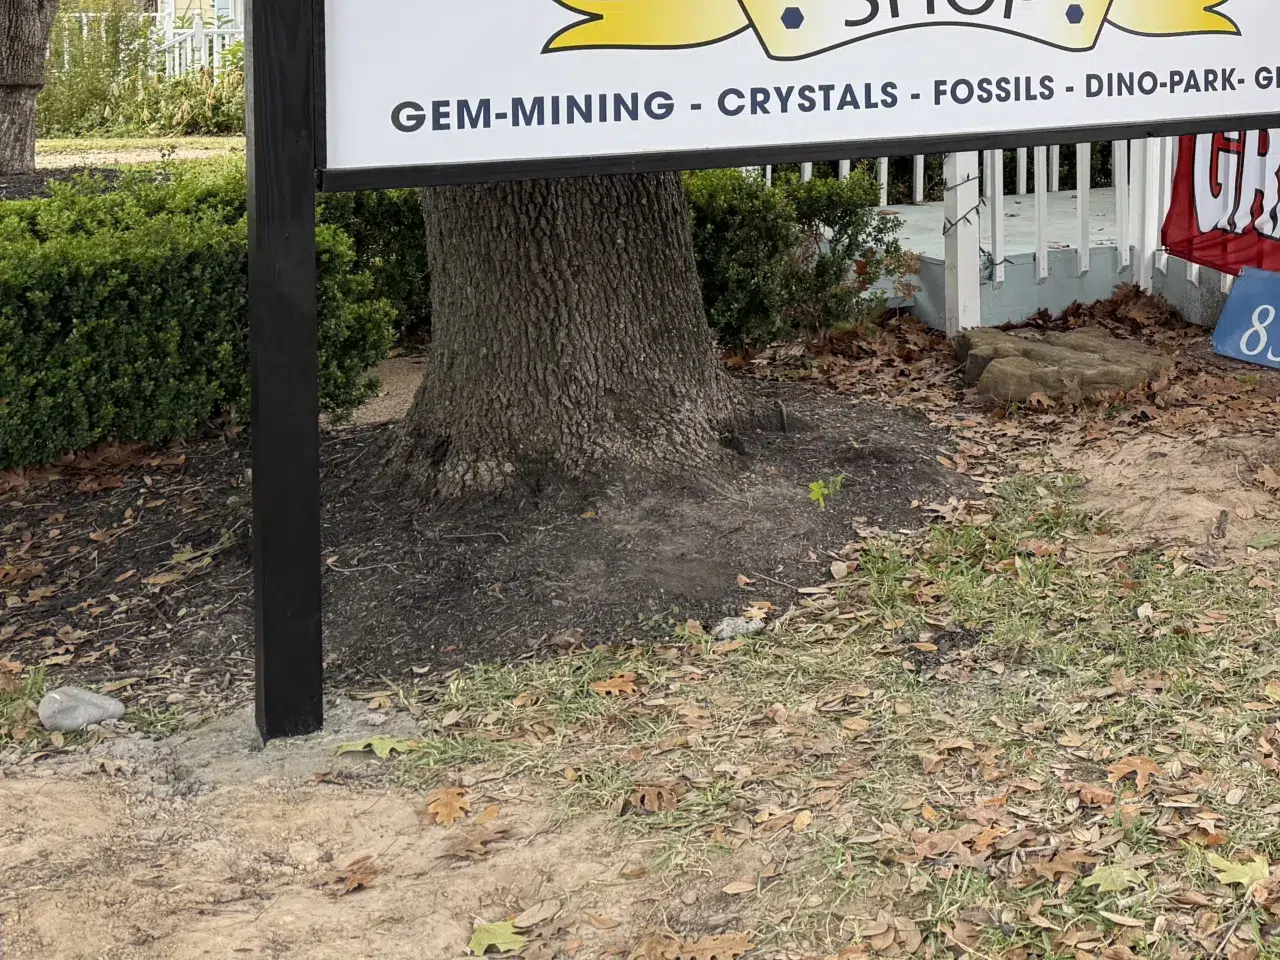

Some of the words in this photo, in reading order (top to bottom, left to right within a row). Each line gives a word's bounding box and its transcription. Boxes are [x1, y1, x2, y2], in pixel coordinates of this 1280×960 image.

[390, 91, 675, 133] GEM-MINING
[717, 81, 898, 117] CRYSTALS
[934, 75, 1055, 105] FOSSILS
[1085, 67, 1245, 98] DINO-PARK-
